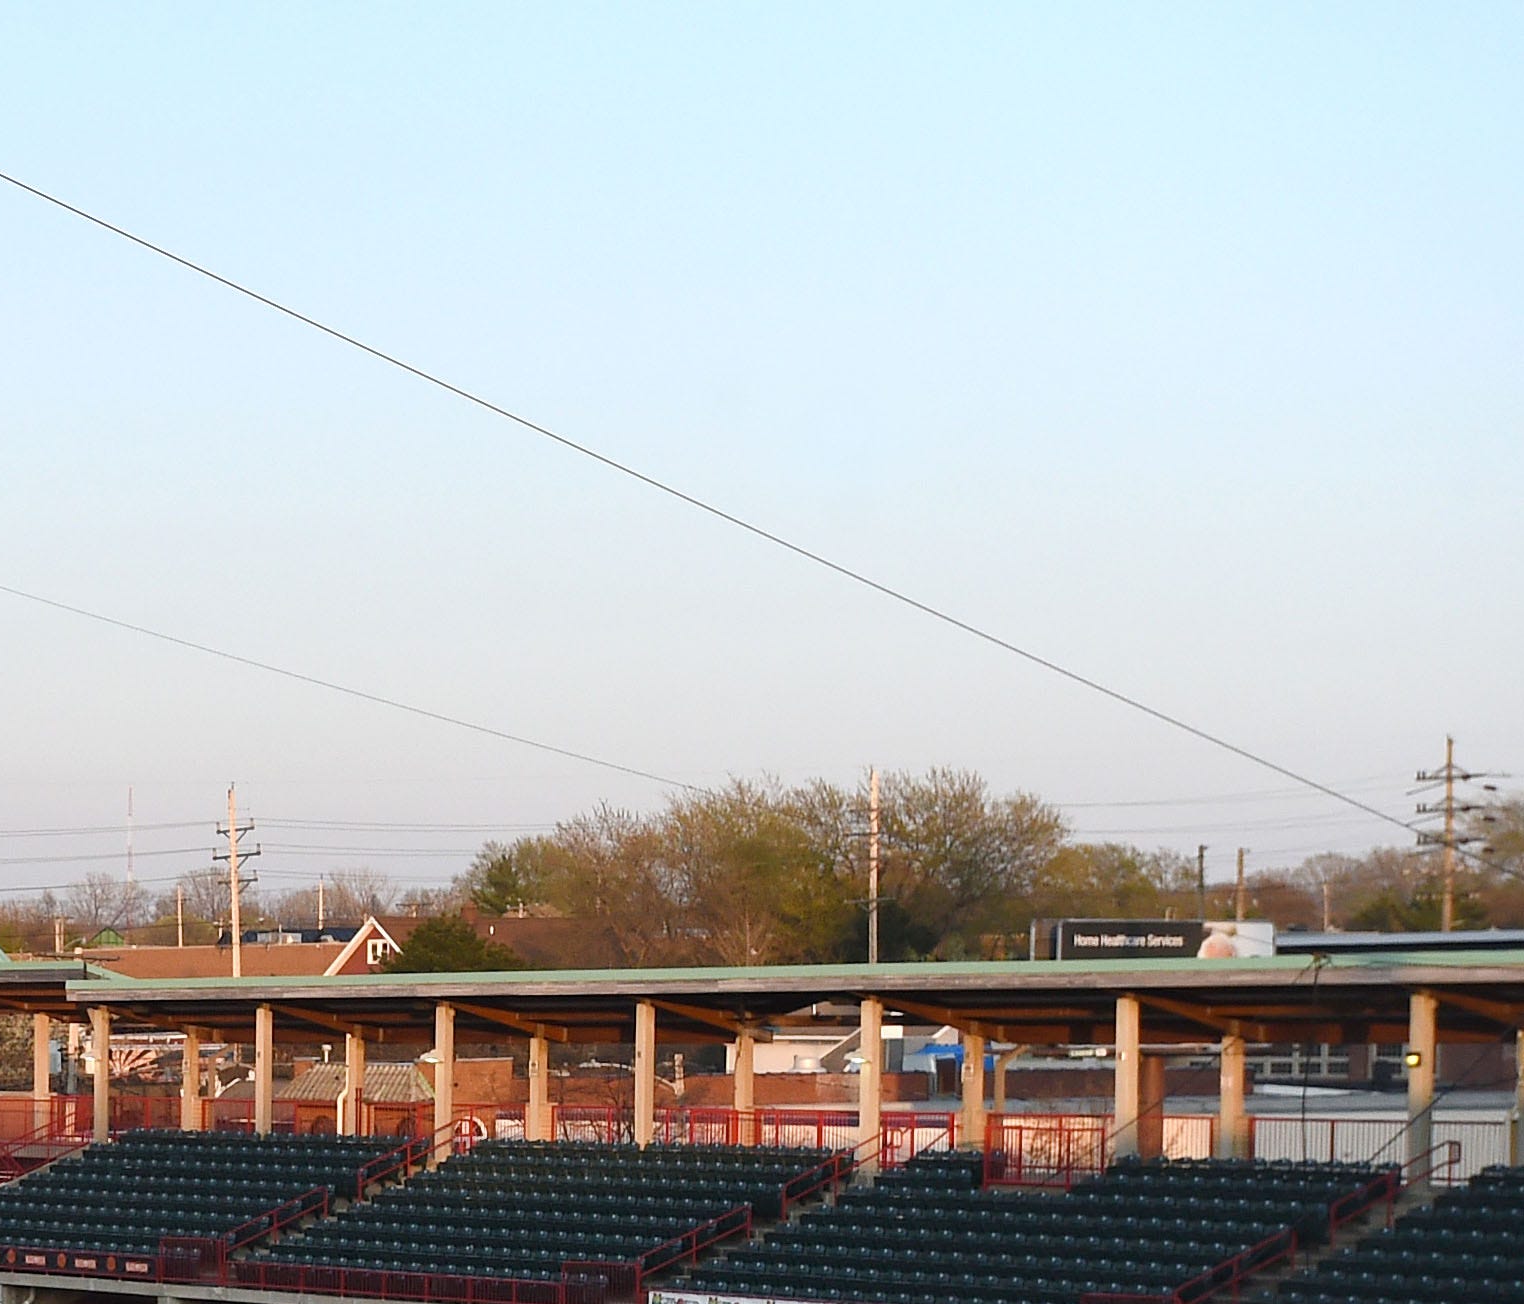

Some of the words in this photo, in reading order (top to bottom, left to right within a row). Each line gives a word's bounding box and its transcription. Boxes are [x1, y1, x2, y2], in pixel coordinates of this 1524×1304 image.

[1073, 933, 1099, 947] Home
[1101, 933, 1146, 948] Healthcare
[1147, 933, 1184, 948] Services
